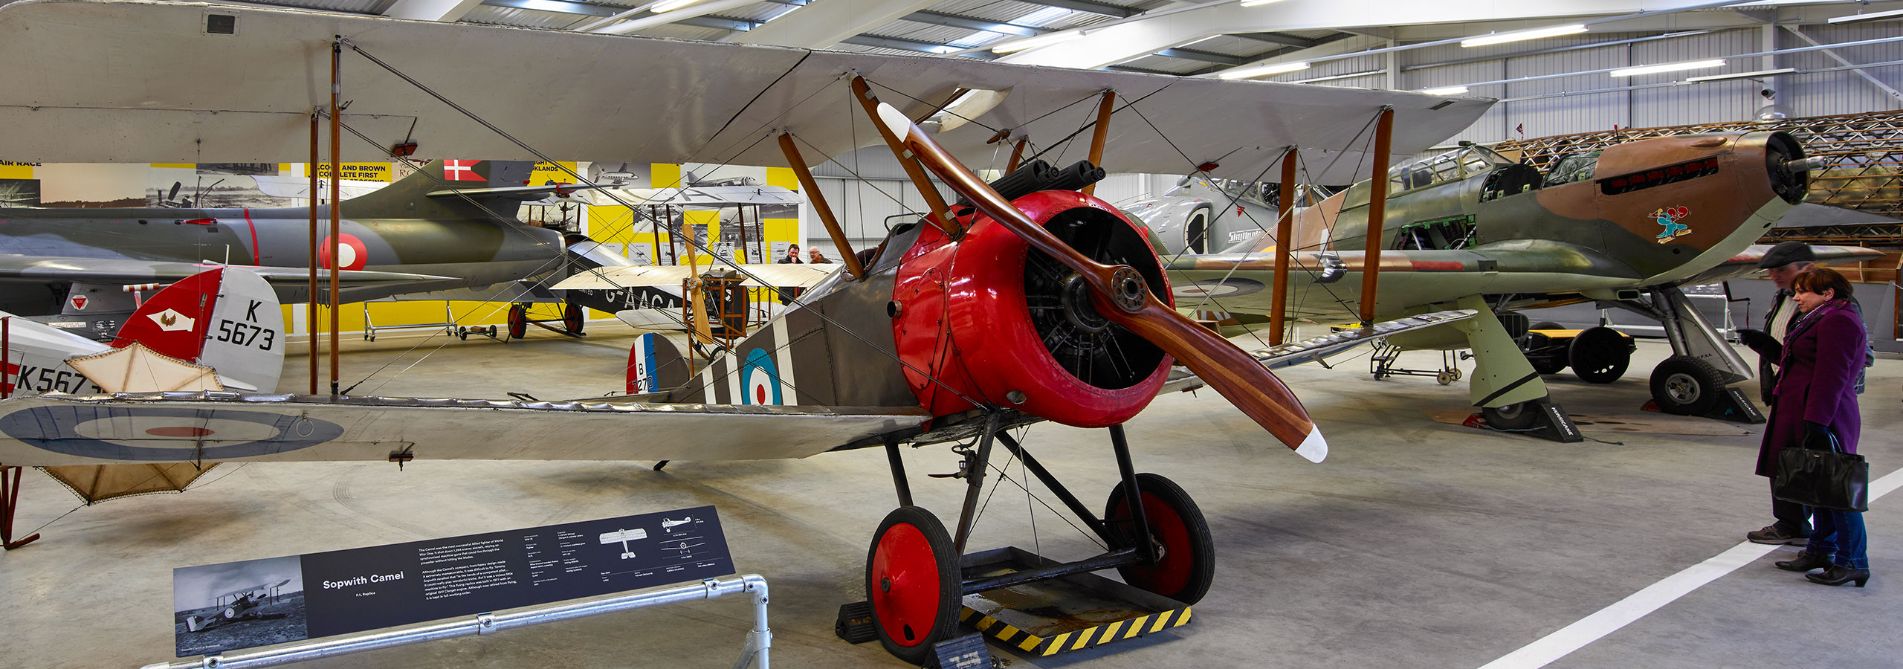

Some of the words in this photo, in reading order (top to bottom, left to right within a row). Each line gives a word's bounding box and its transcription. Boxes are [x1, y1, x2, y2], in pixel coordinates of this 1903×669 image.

[245, 299, 263, 323] K
[216, 319, 275, 351] 5673
[17, 365, 108, 394] K567
[638, 363, 644, 376] B
[323, 575, 368, 590] Sopwith
[370, 570, 404, 583] Camel
